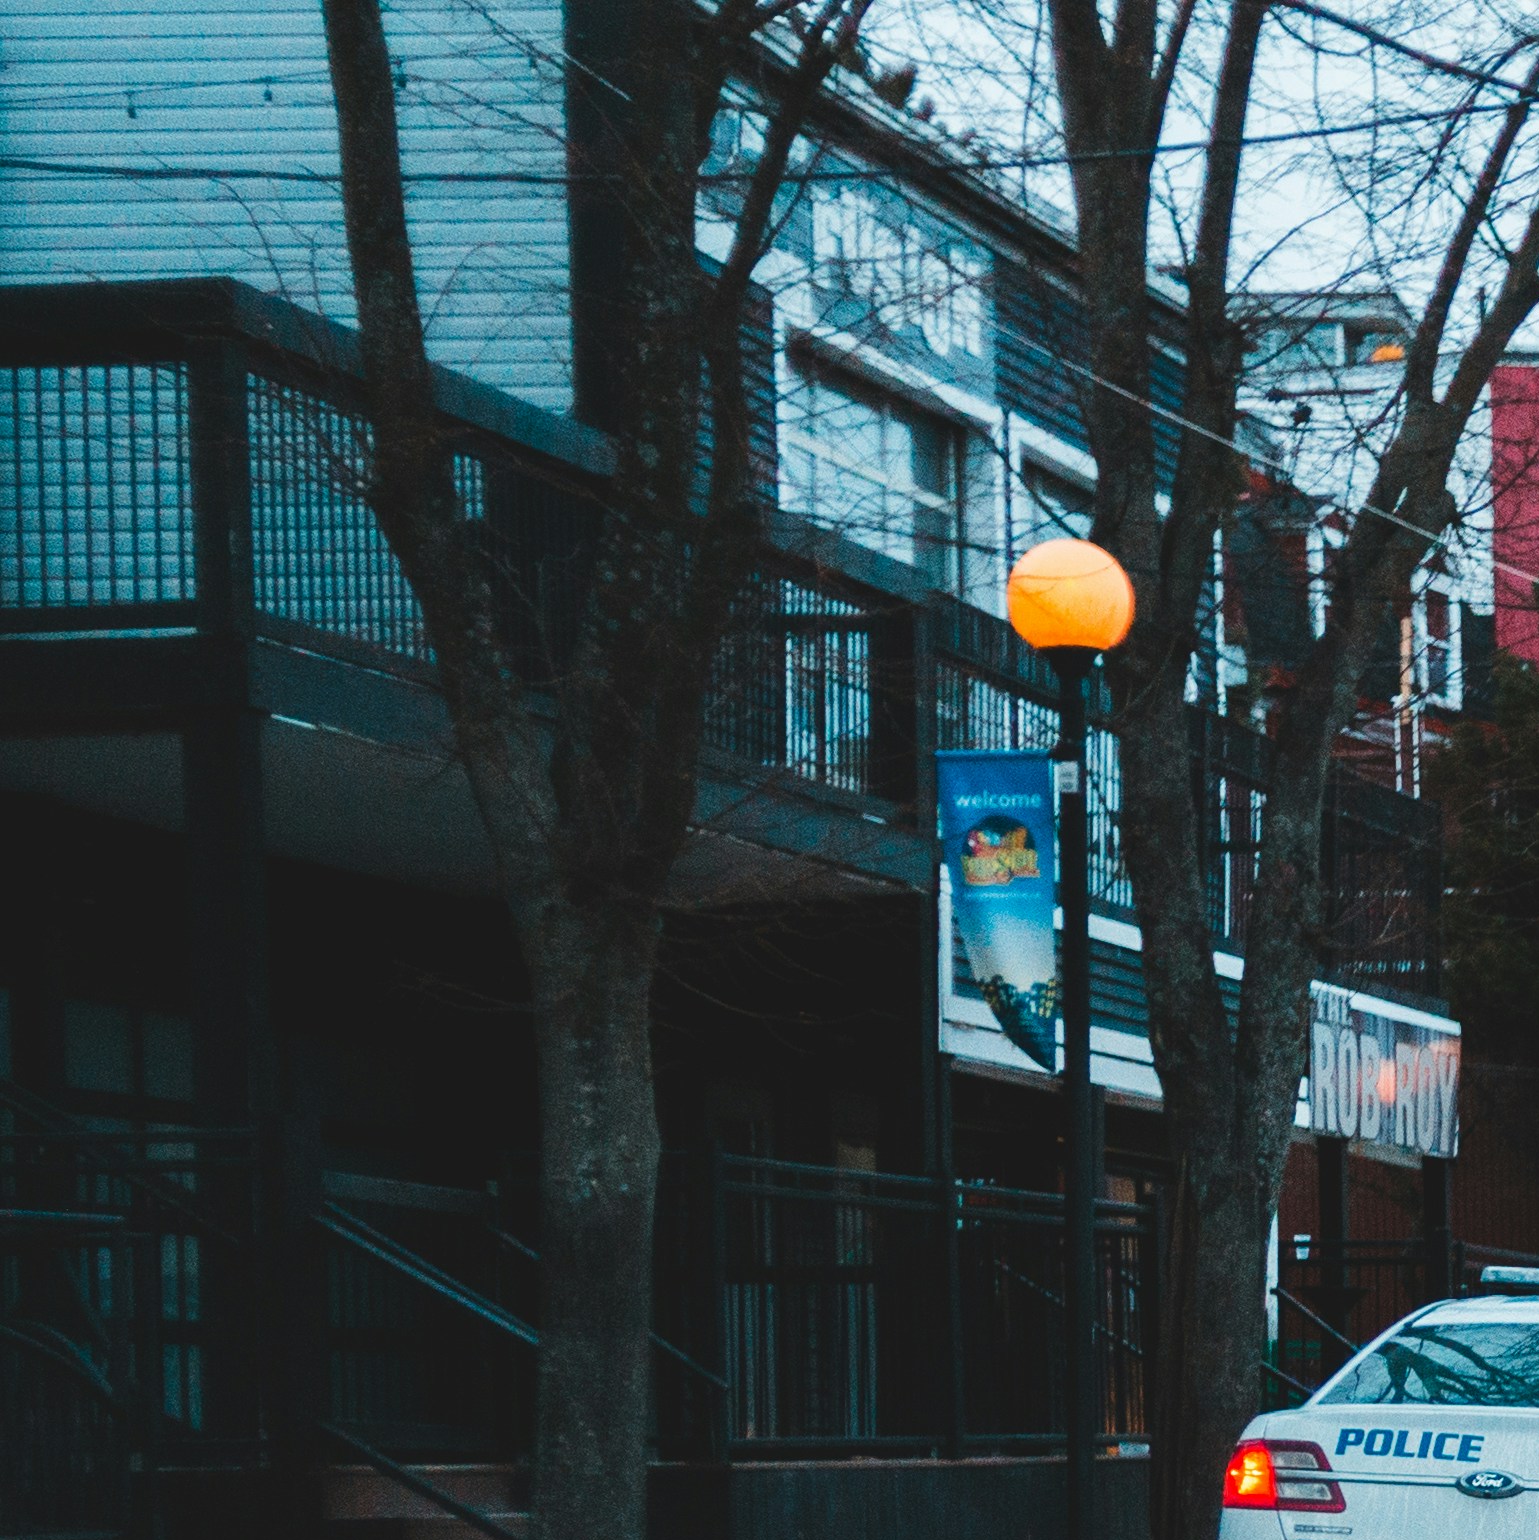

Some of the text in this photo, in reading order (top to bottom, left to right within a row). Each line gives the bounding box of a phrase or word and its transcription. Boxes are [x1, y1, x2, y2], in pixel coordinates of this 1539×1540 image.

[955, 790, 1042, 809] welcome
[1313, 1022, 1457, 1153] ROB ROY
[1335, 1428, 1485, 1463] POLICE
[1472, 1474, 1504, 1488] Ford
